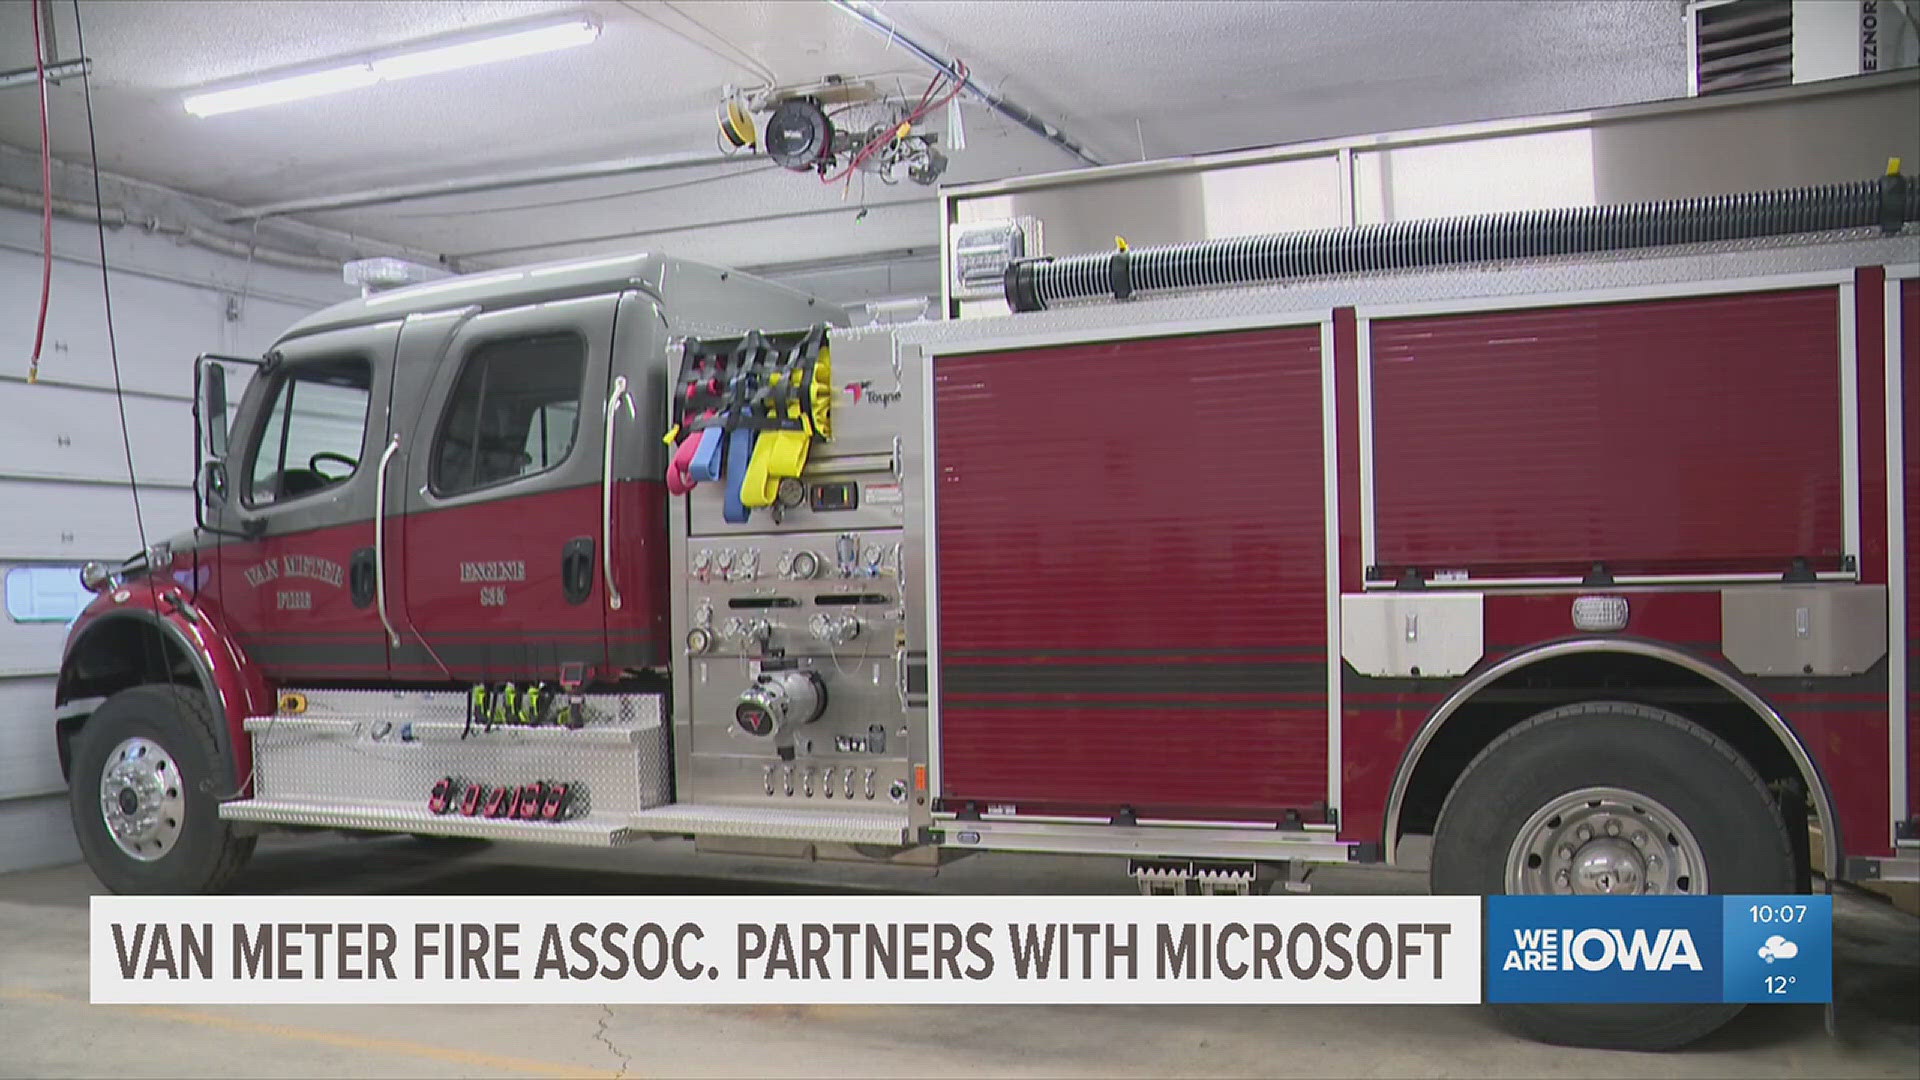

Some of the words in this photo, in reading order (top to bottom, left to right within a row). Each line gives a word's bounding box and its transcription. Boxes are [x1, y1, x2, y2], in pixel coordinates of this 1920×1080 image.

[244, 558, 279, 588] VAN
[283, 555, 344, 588] METER
[460, 561, 525, 582] ENGINE
[277, 591, 312, 609] FIRE
